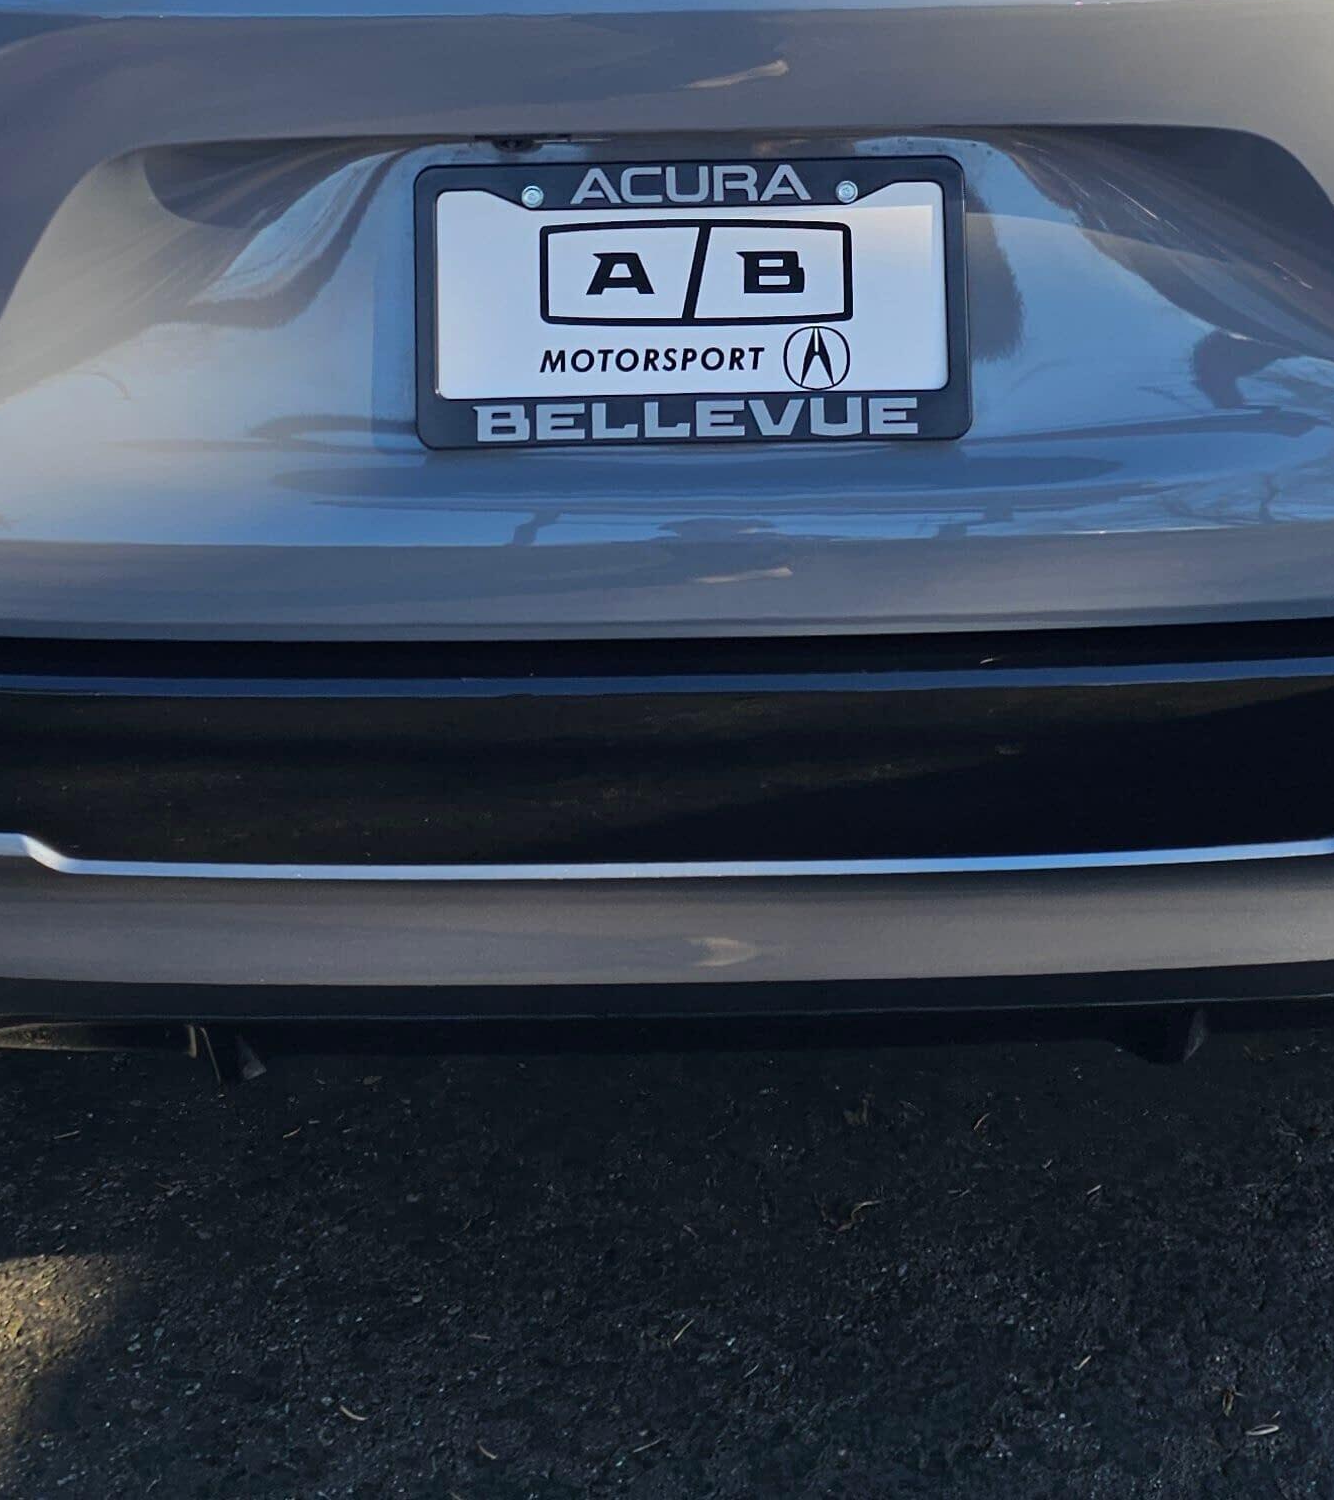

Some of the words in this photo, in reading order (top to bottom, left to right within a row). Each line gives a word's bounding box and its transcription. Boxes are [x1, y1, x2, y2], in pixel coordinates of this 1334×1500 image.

[570, 164, 812, 204] ACURA
[539, 347, 765, 374] MOTORSPORT
[473, 396, 919, 442] BELLEVUE
